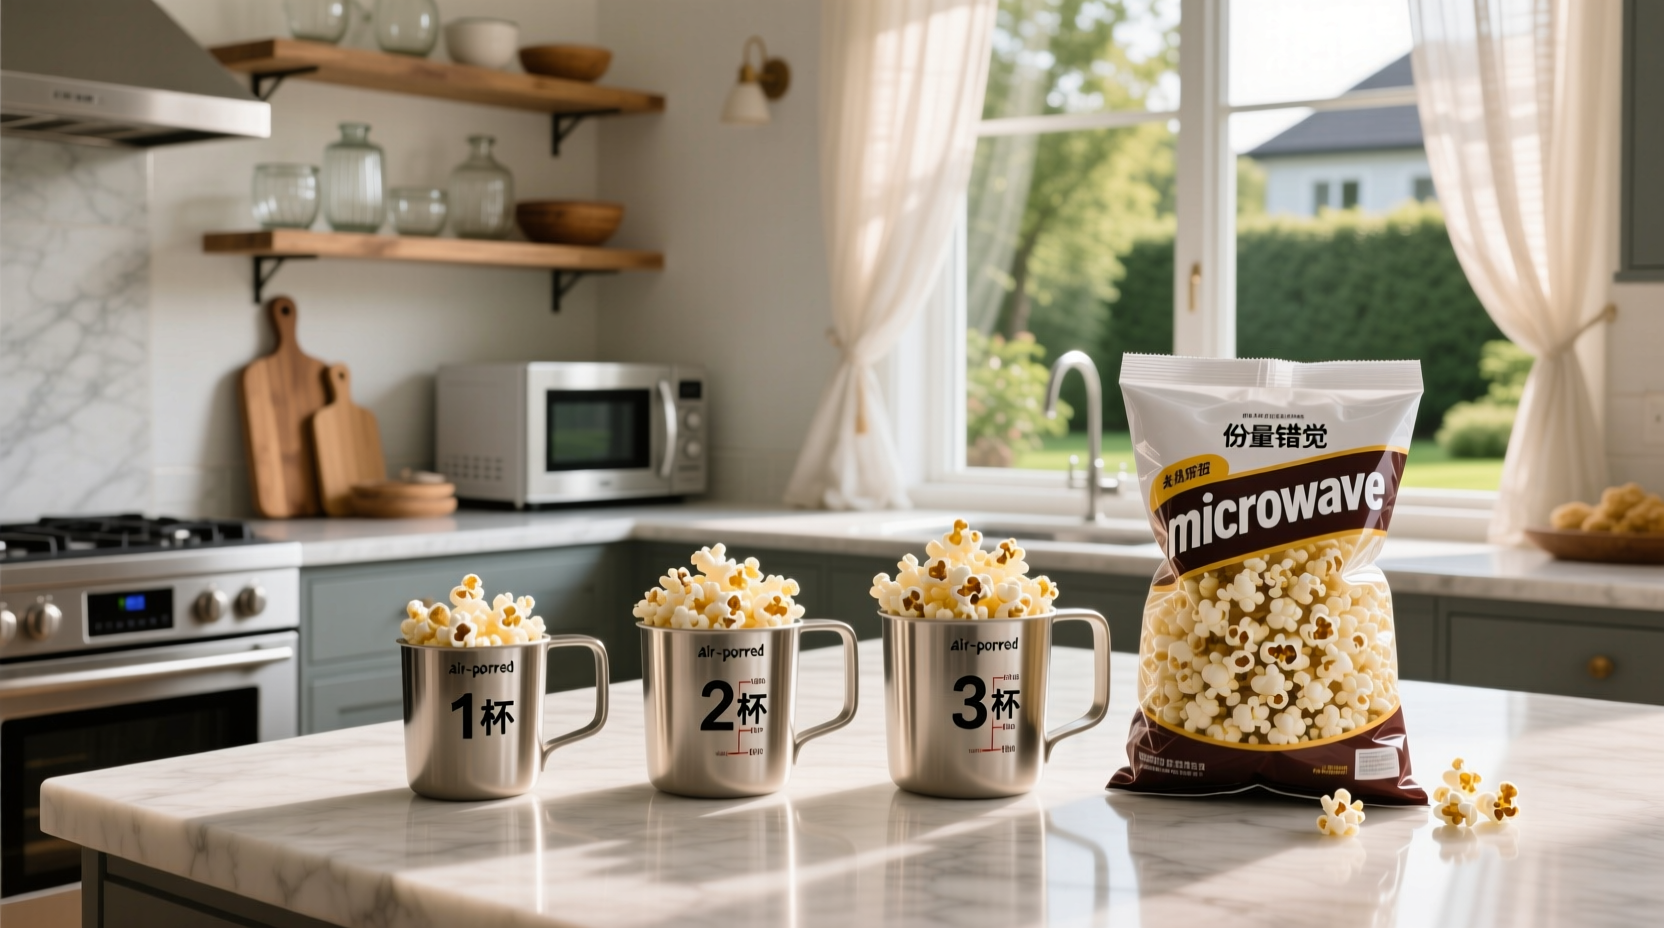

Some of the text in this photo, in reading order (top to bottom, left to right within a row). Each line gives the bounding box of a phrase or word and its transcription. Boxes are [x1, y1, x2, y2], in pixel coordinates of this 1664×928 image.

[1223, 423, 1328, 449] 份量错觉
[1168, 471, 1386, 558] microwave
